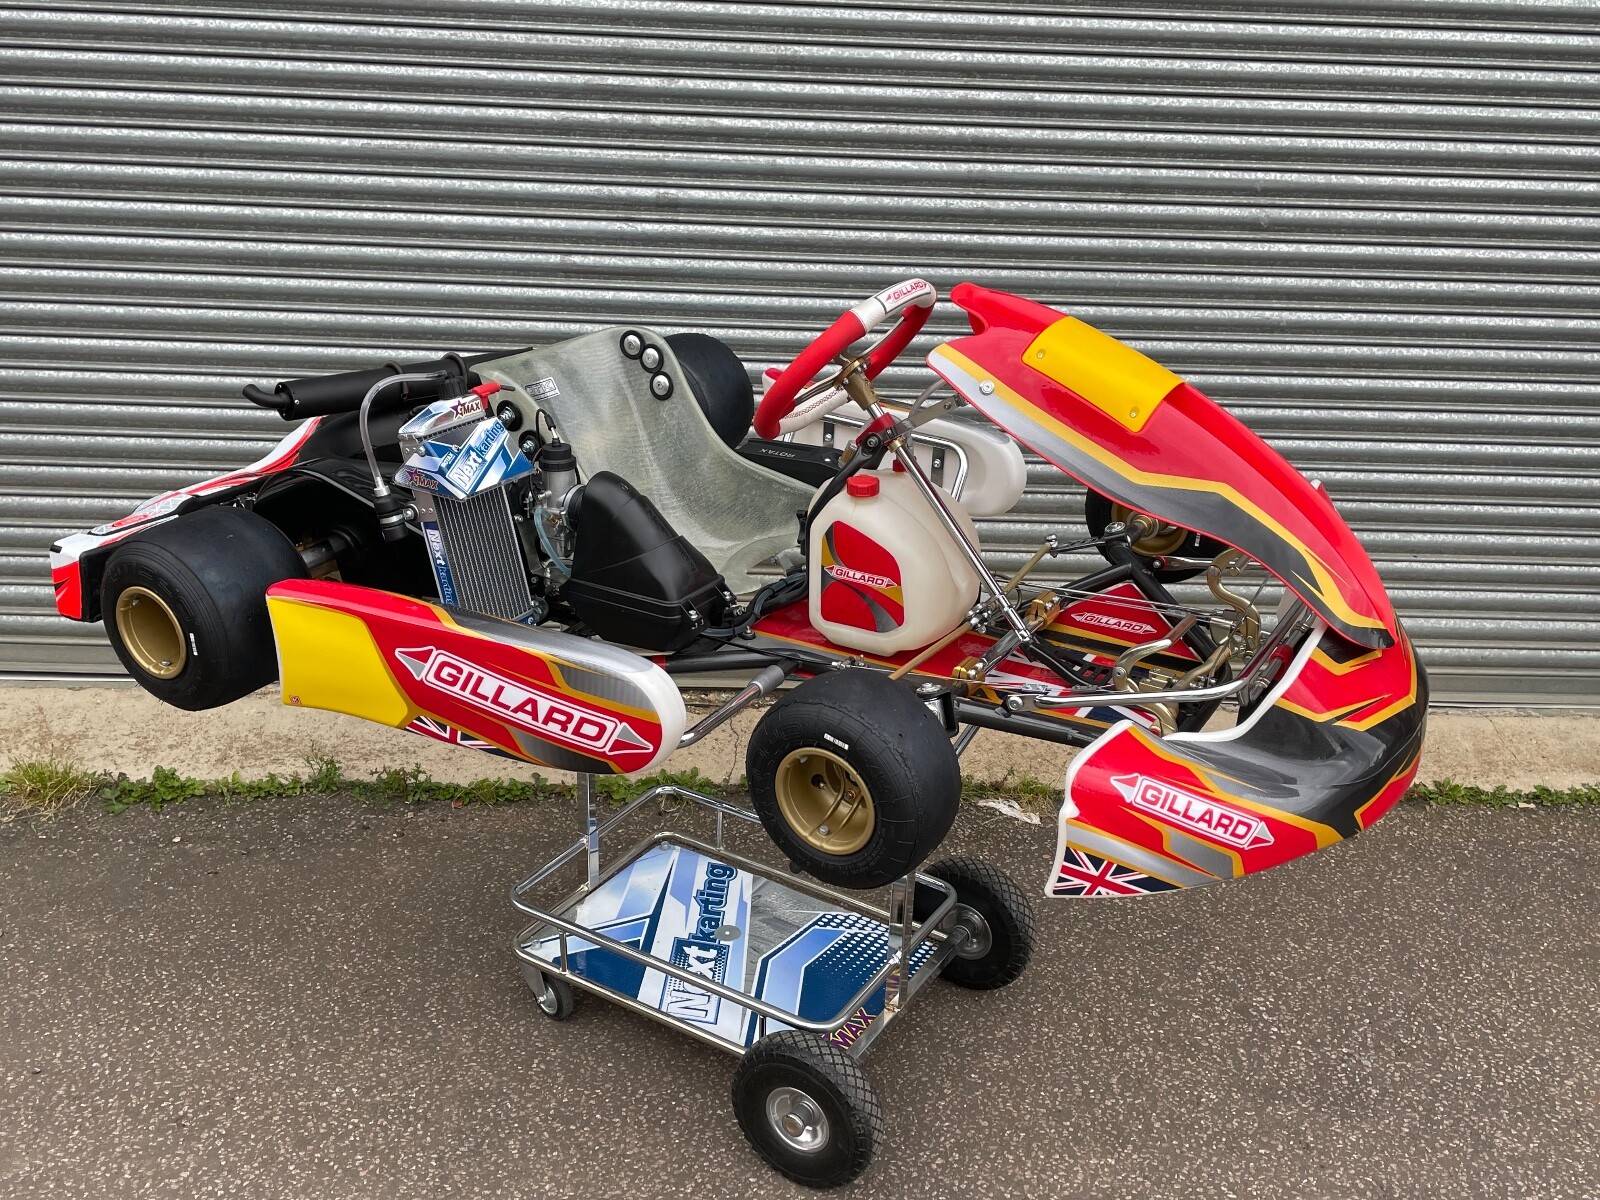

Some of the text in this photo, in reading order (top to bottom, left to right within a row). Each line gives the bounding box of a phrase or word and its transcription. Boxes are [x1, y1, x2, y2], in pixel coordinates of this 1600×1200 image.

[893, 281, 924, 300] GILLARD
[452, 420, 505, 488] Next karting
[760, 448, 796, 458] ROTAX
[426, 529, 446, 566] Next
[835, 568, 885, 586] GILLARD
[1084, 614, 1143, 631] GILLARD
[433, 660, 607, 743] GILLARD
[1141, 784, 1253, 840] GILLARD
[692, 862, 738, 944] karting
